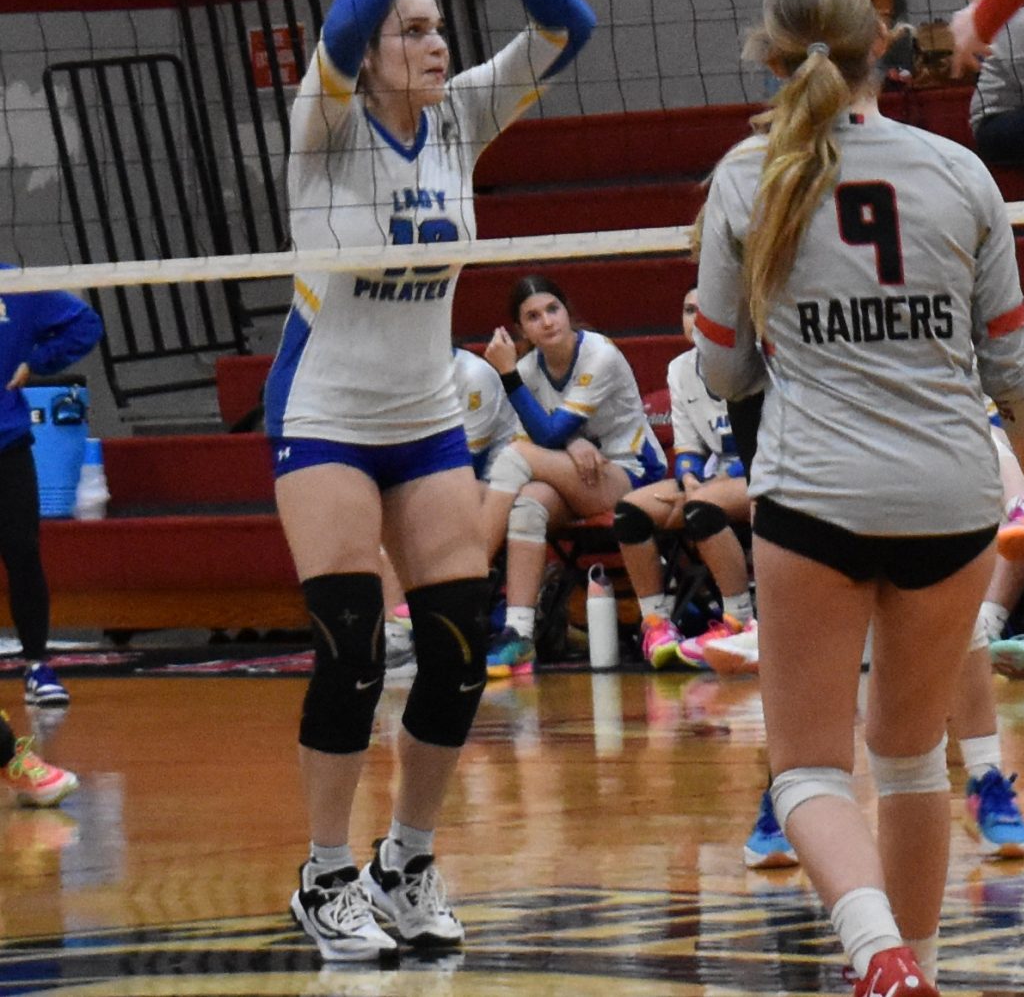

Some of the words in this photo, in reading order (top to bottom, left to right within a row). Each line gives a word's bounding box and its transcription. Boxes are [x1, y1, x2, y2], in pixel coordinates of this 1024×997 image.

[392, 186, 446, 212] LADY
[834, 178, 906, 286] 9
[353, 276, 451, 302] PIRATES
[797, 294, 954, 344] RAIDERS
